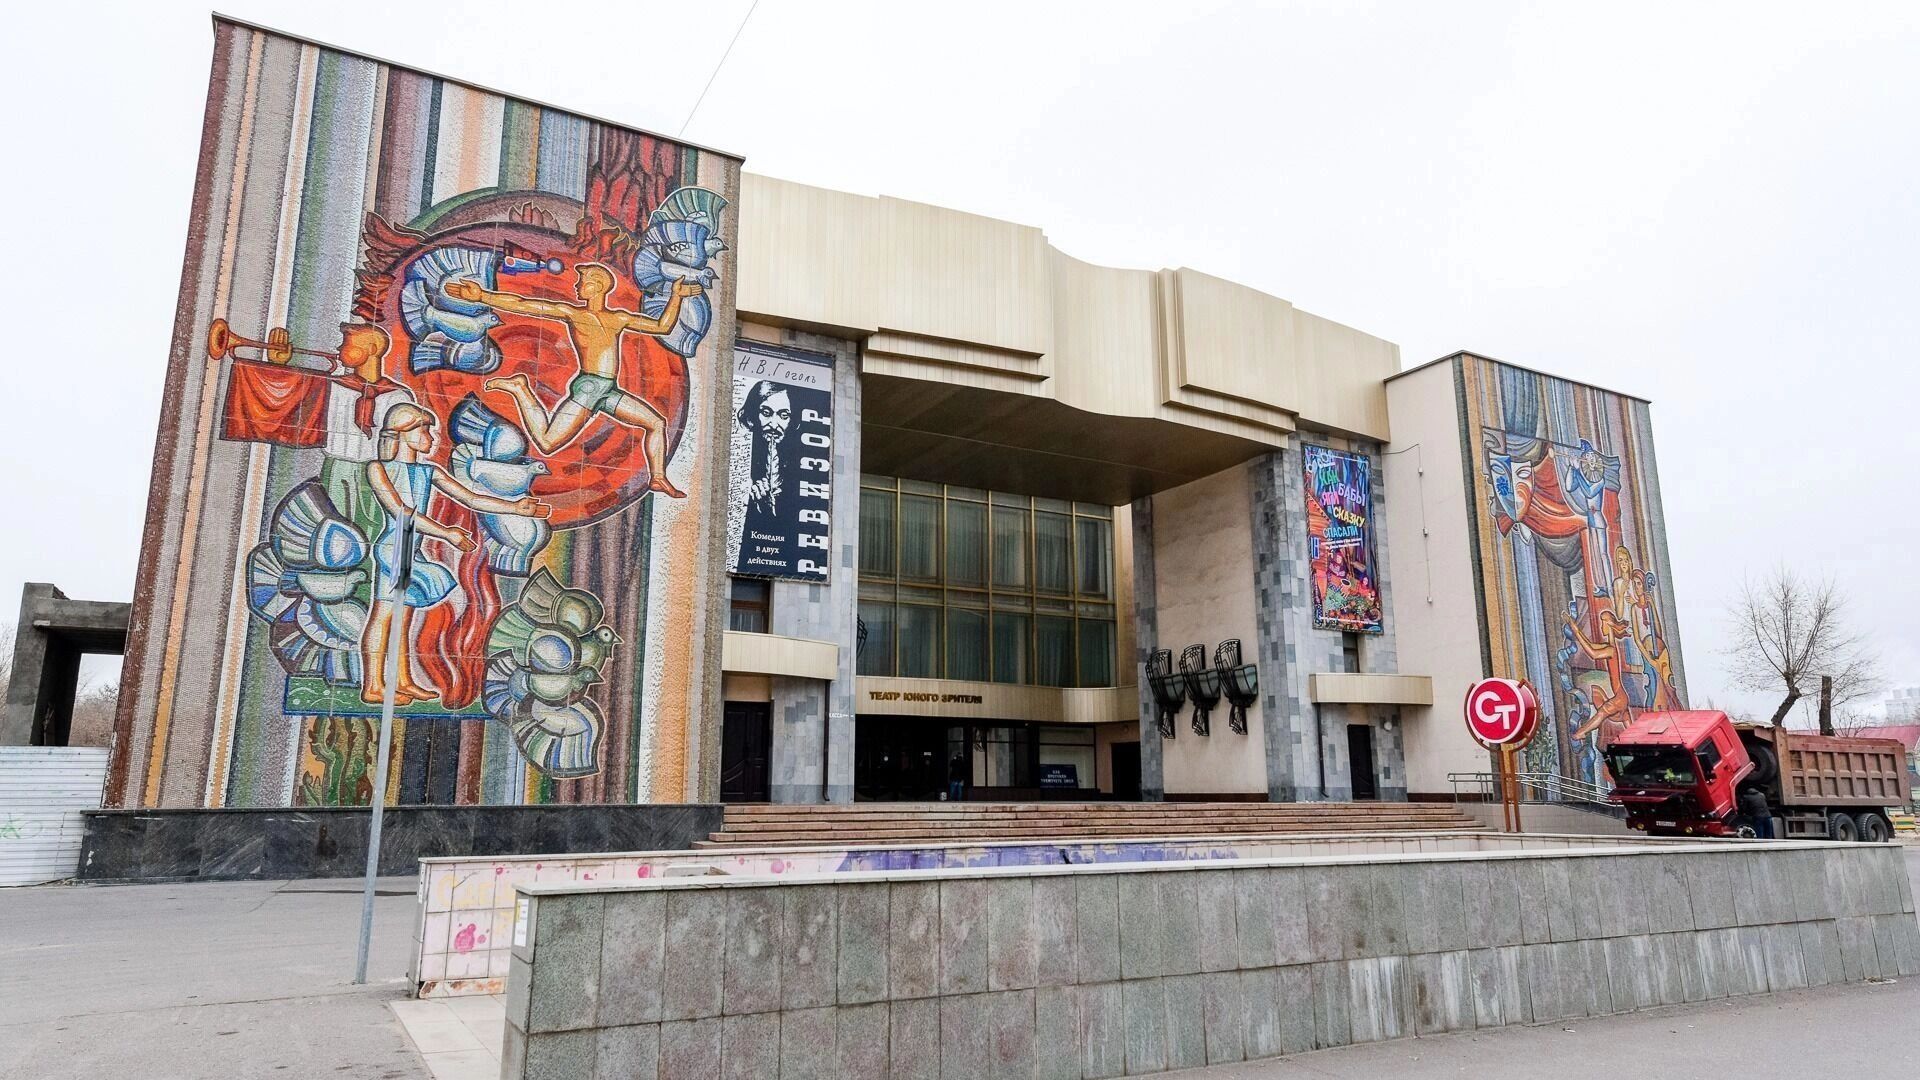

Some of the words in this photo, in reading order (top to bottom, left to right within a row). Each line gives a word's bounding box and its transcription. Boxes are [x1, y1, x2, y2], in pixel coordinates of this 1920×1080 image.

[797, 408, 832, 575] РЕВИЗОР
[1338, 482, 1366, 507] БАБЫ
[1332, 506, 1366, 528] СКАЗКУ
[750, 530, 785, 542] Комедия
[1322, 525, 1359, 538] СПАСАЛИ
[761, 546, 780, 556] двух
[747, 556, 787, 567] действиях
[869, 691, 900, 701] ТЕАТР
[903, 692, 939, 703] ЮНОГО
[941, 694, 983, 705] ЗРИТЕЛЯ
